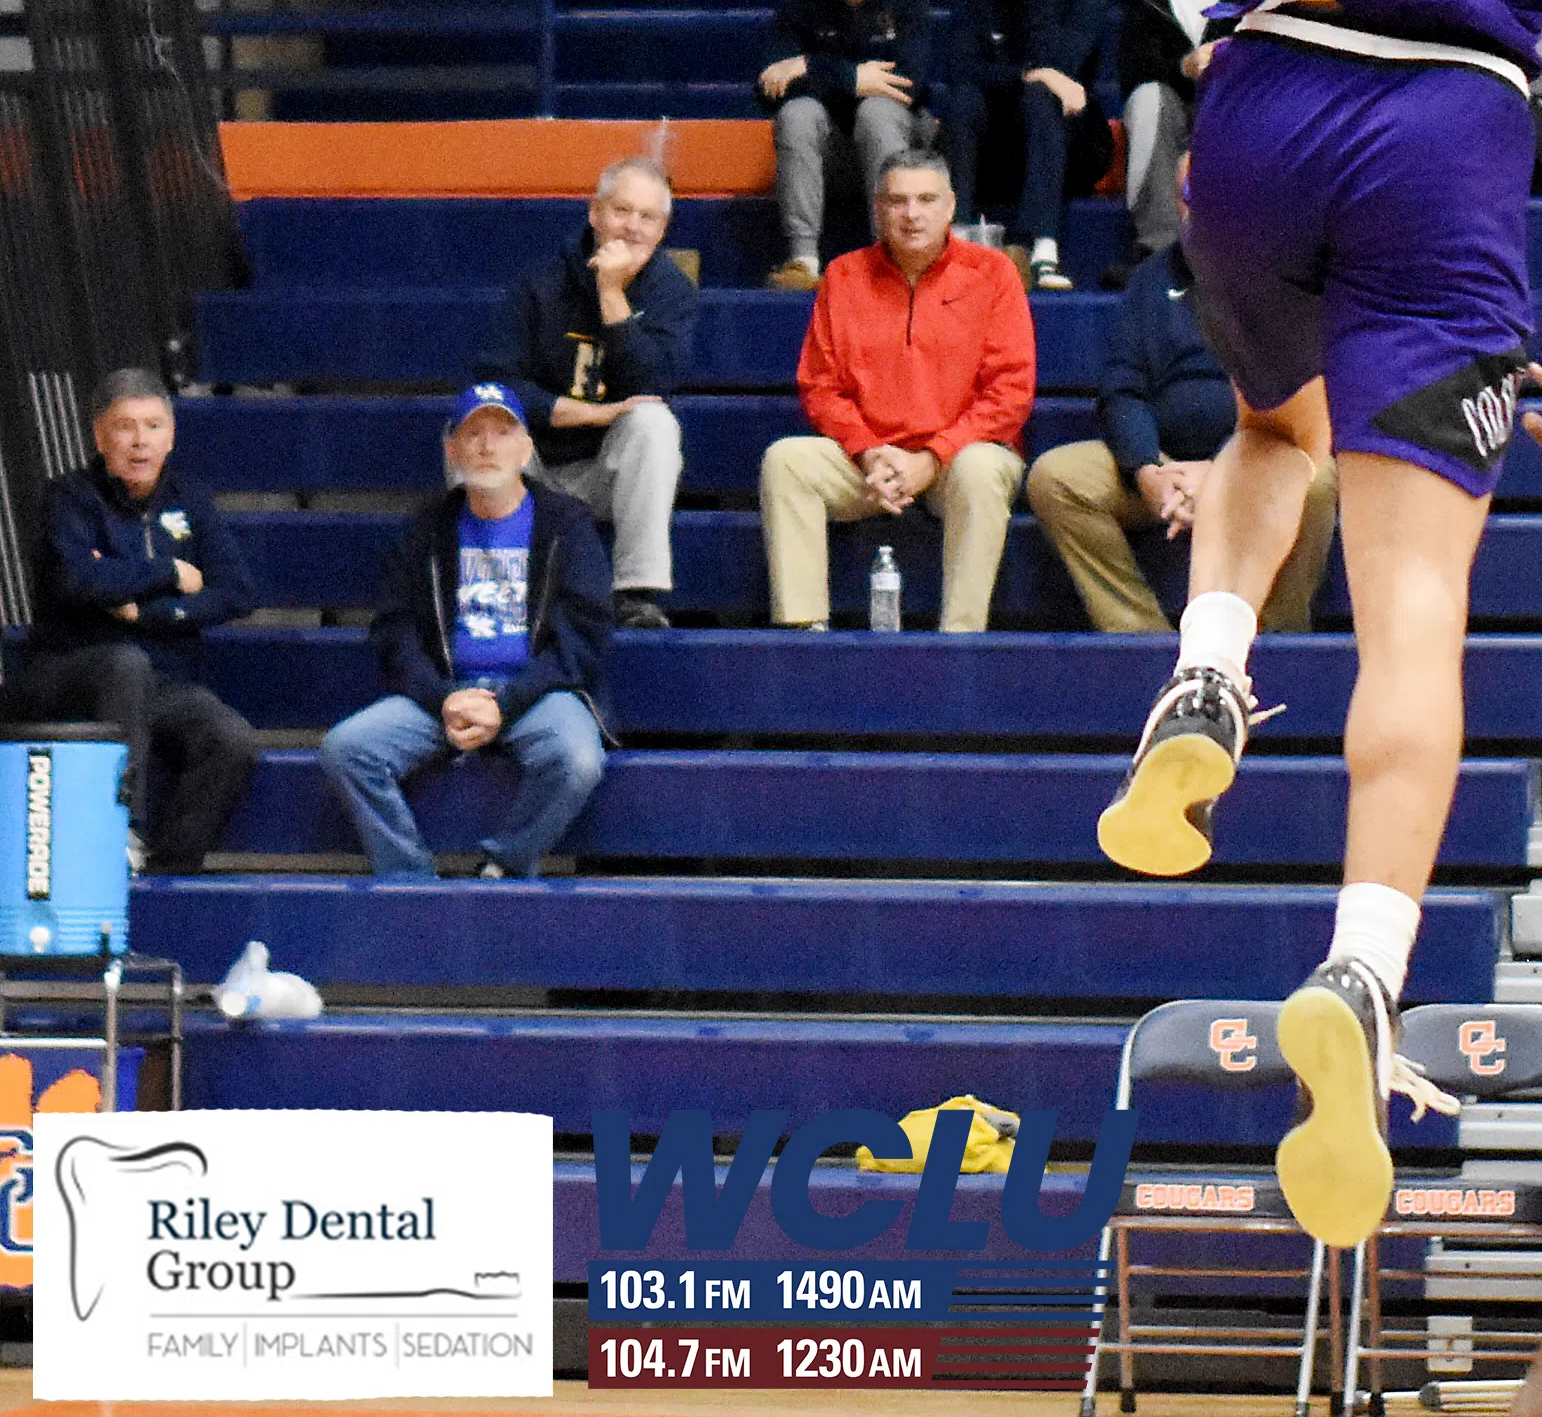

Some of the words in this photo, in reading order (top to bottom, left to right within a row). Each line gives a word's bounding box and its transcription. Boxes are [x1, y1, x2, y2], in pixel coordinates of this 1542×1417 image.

[28, 754, 52, 894] POWERADE
[1136, 1184, 1255, 1211] COUGARS
[1396, 1189, 1516, 1215] COUGARS
